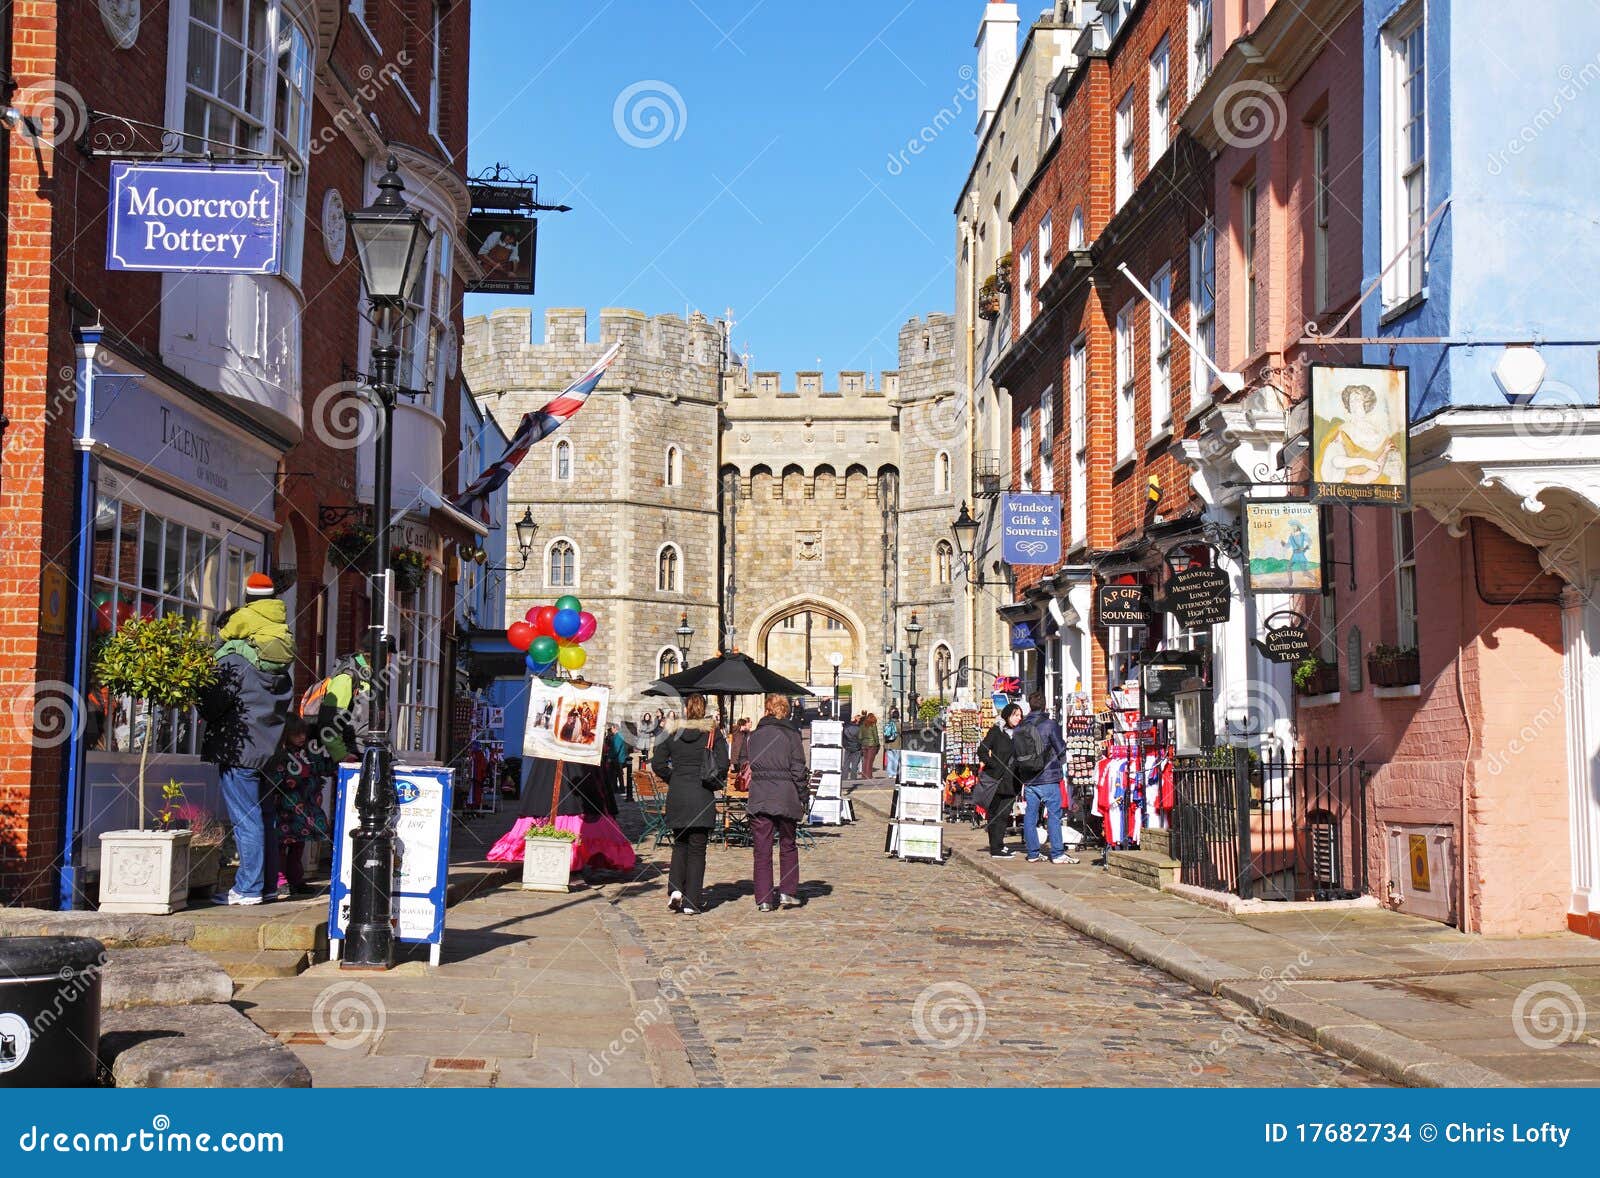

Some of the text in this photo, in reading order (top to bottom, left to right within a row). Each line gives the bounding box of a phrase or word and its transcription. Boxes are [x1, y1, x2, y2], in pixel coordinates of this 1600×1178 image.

[127, 186, 270, 219] Moorcroft
[144, 221, 247, 259] Pottery
[160, 405, 210, 465] TALENTS
[1008, 503, 1053, 513] Windsor
[1283, 505, 1313, 515] House
[1011, 515, 1051, 525] Gifts &
[1005, 526, 1058, 537] Souvenirs
[1177, 571, 1215, 583] BREAKFAST
[1172, 579, 1224, 593] MORNING COFFEE
[1189, 591, 1211, 599] LUNCH
[1123, 600, 1131, 609] &
[1176, 596, 1227, 611] AFTERNOON TEA
[1187, 609, 1204, 618] HIGH
[1269, 630, 1305, 641] ENGLISH
[1269, 640, 1309, 652] CLOTTED CREAM
[1279, 652, 1300, 660] TEAS
